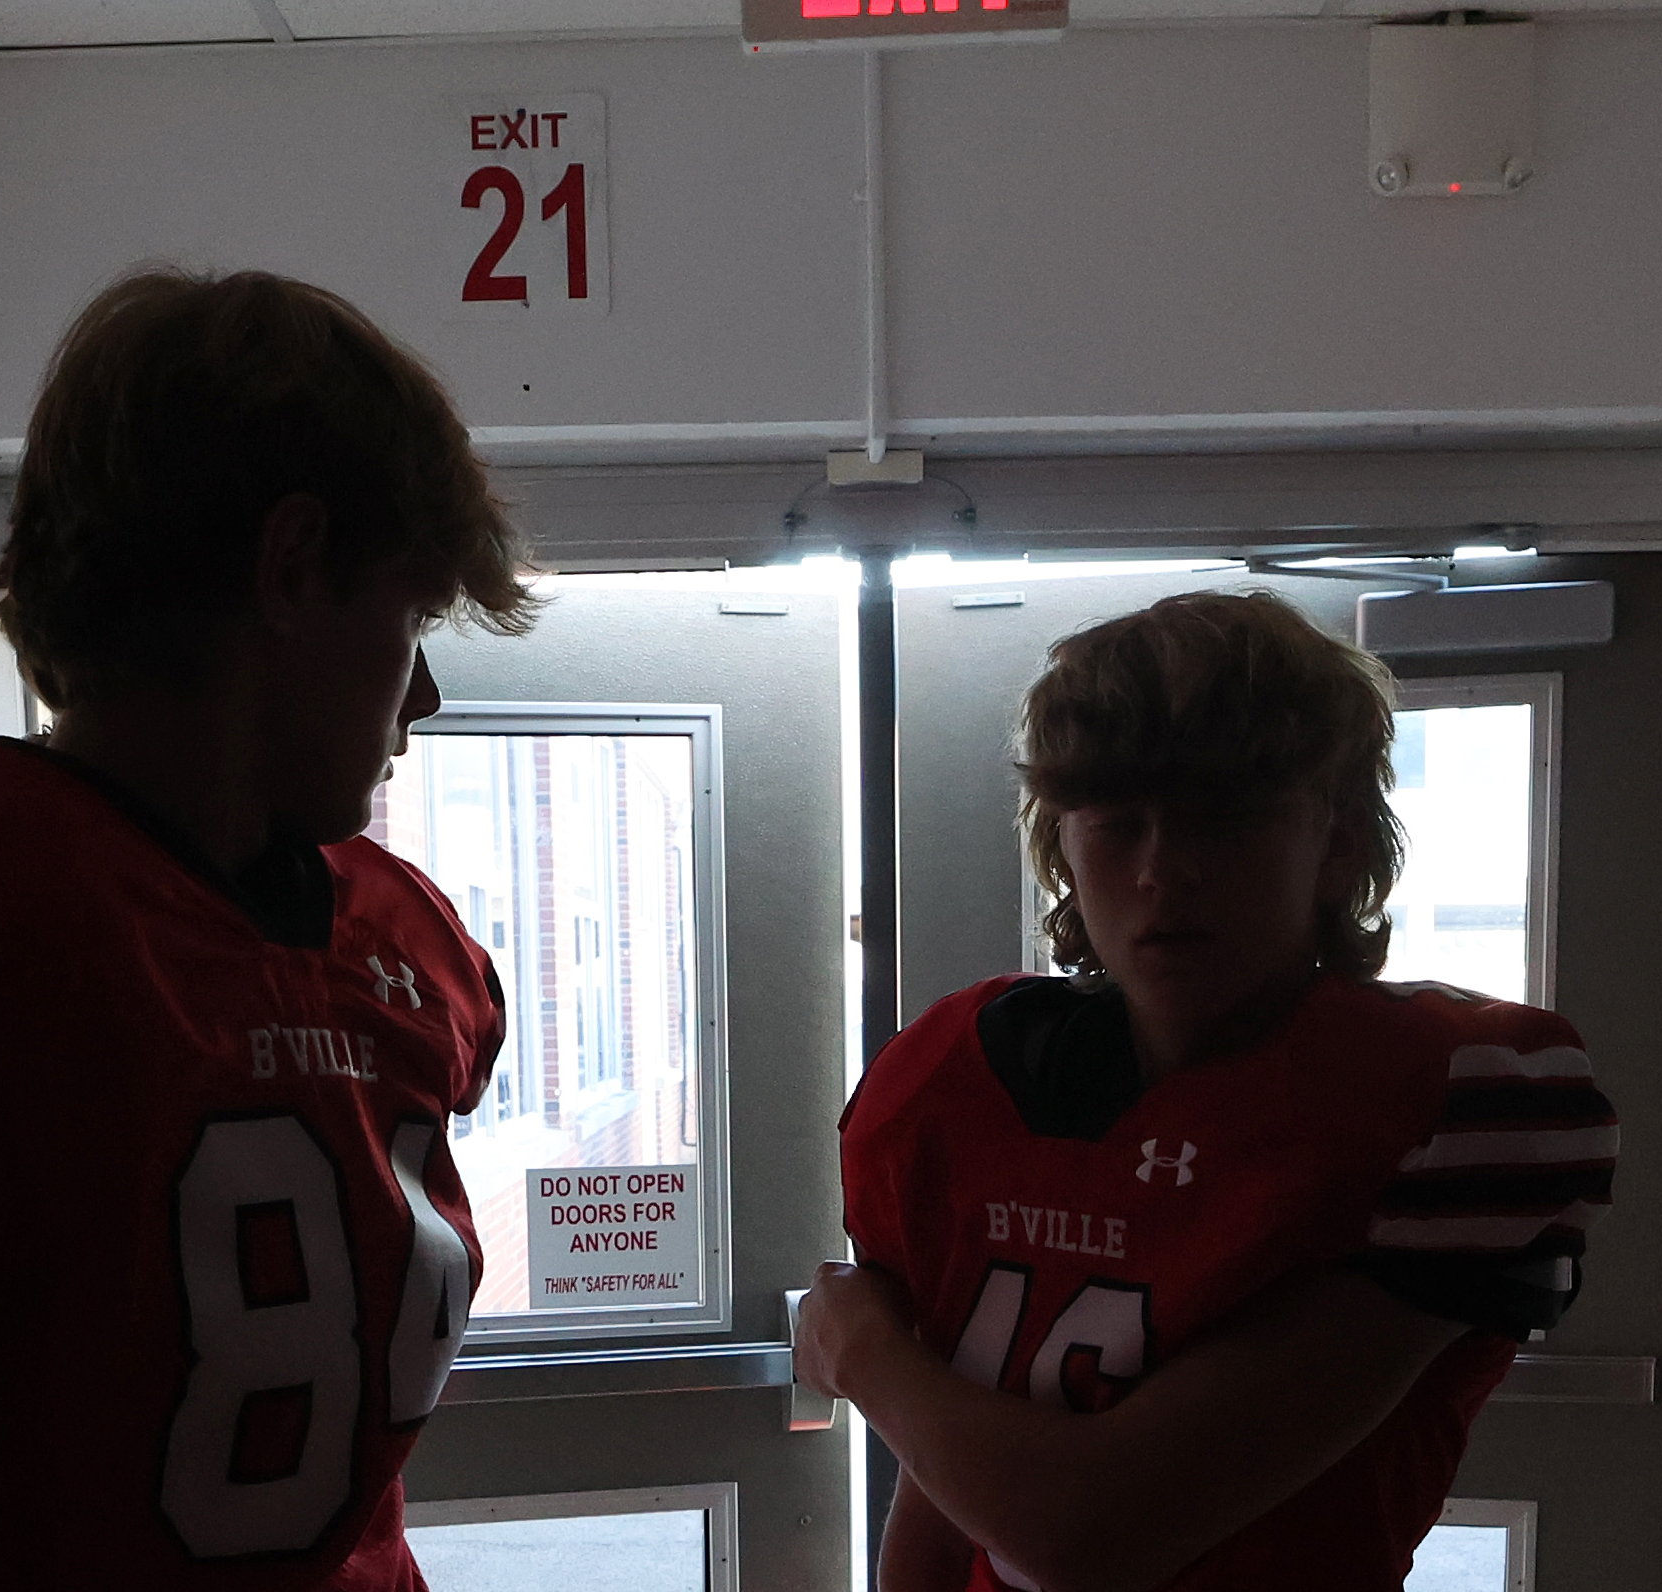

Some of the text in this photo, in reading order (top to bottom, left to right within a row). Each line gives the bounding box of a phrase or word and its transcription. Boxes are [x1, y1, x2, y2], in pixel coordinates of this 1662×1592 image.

[470, 112, 568, 150] EXIT
[460, 162, 588, 302] 21
[246, 1022, 379, 1084] B'VILLE
[540, 1172, 685, 1198] DO NOT OPEN
[551, 1202, 676, 1225] DOORS FOR
[985, 1200, 1127, 1259] B'VILLE
[569, 1230, 659, 1253] ANYONE
[544, 1271, 685, 1295] THINK "SAFETY FOR ALL"
